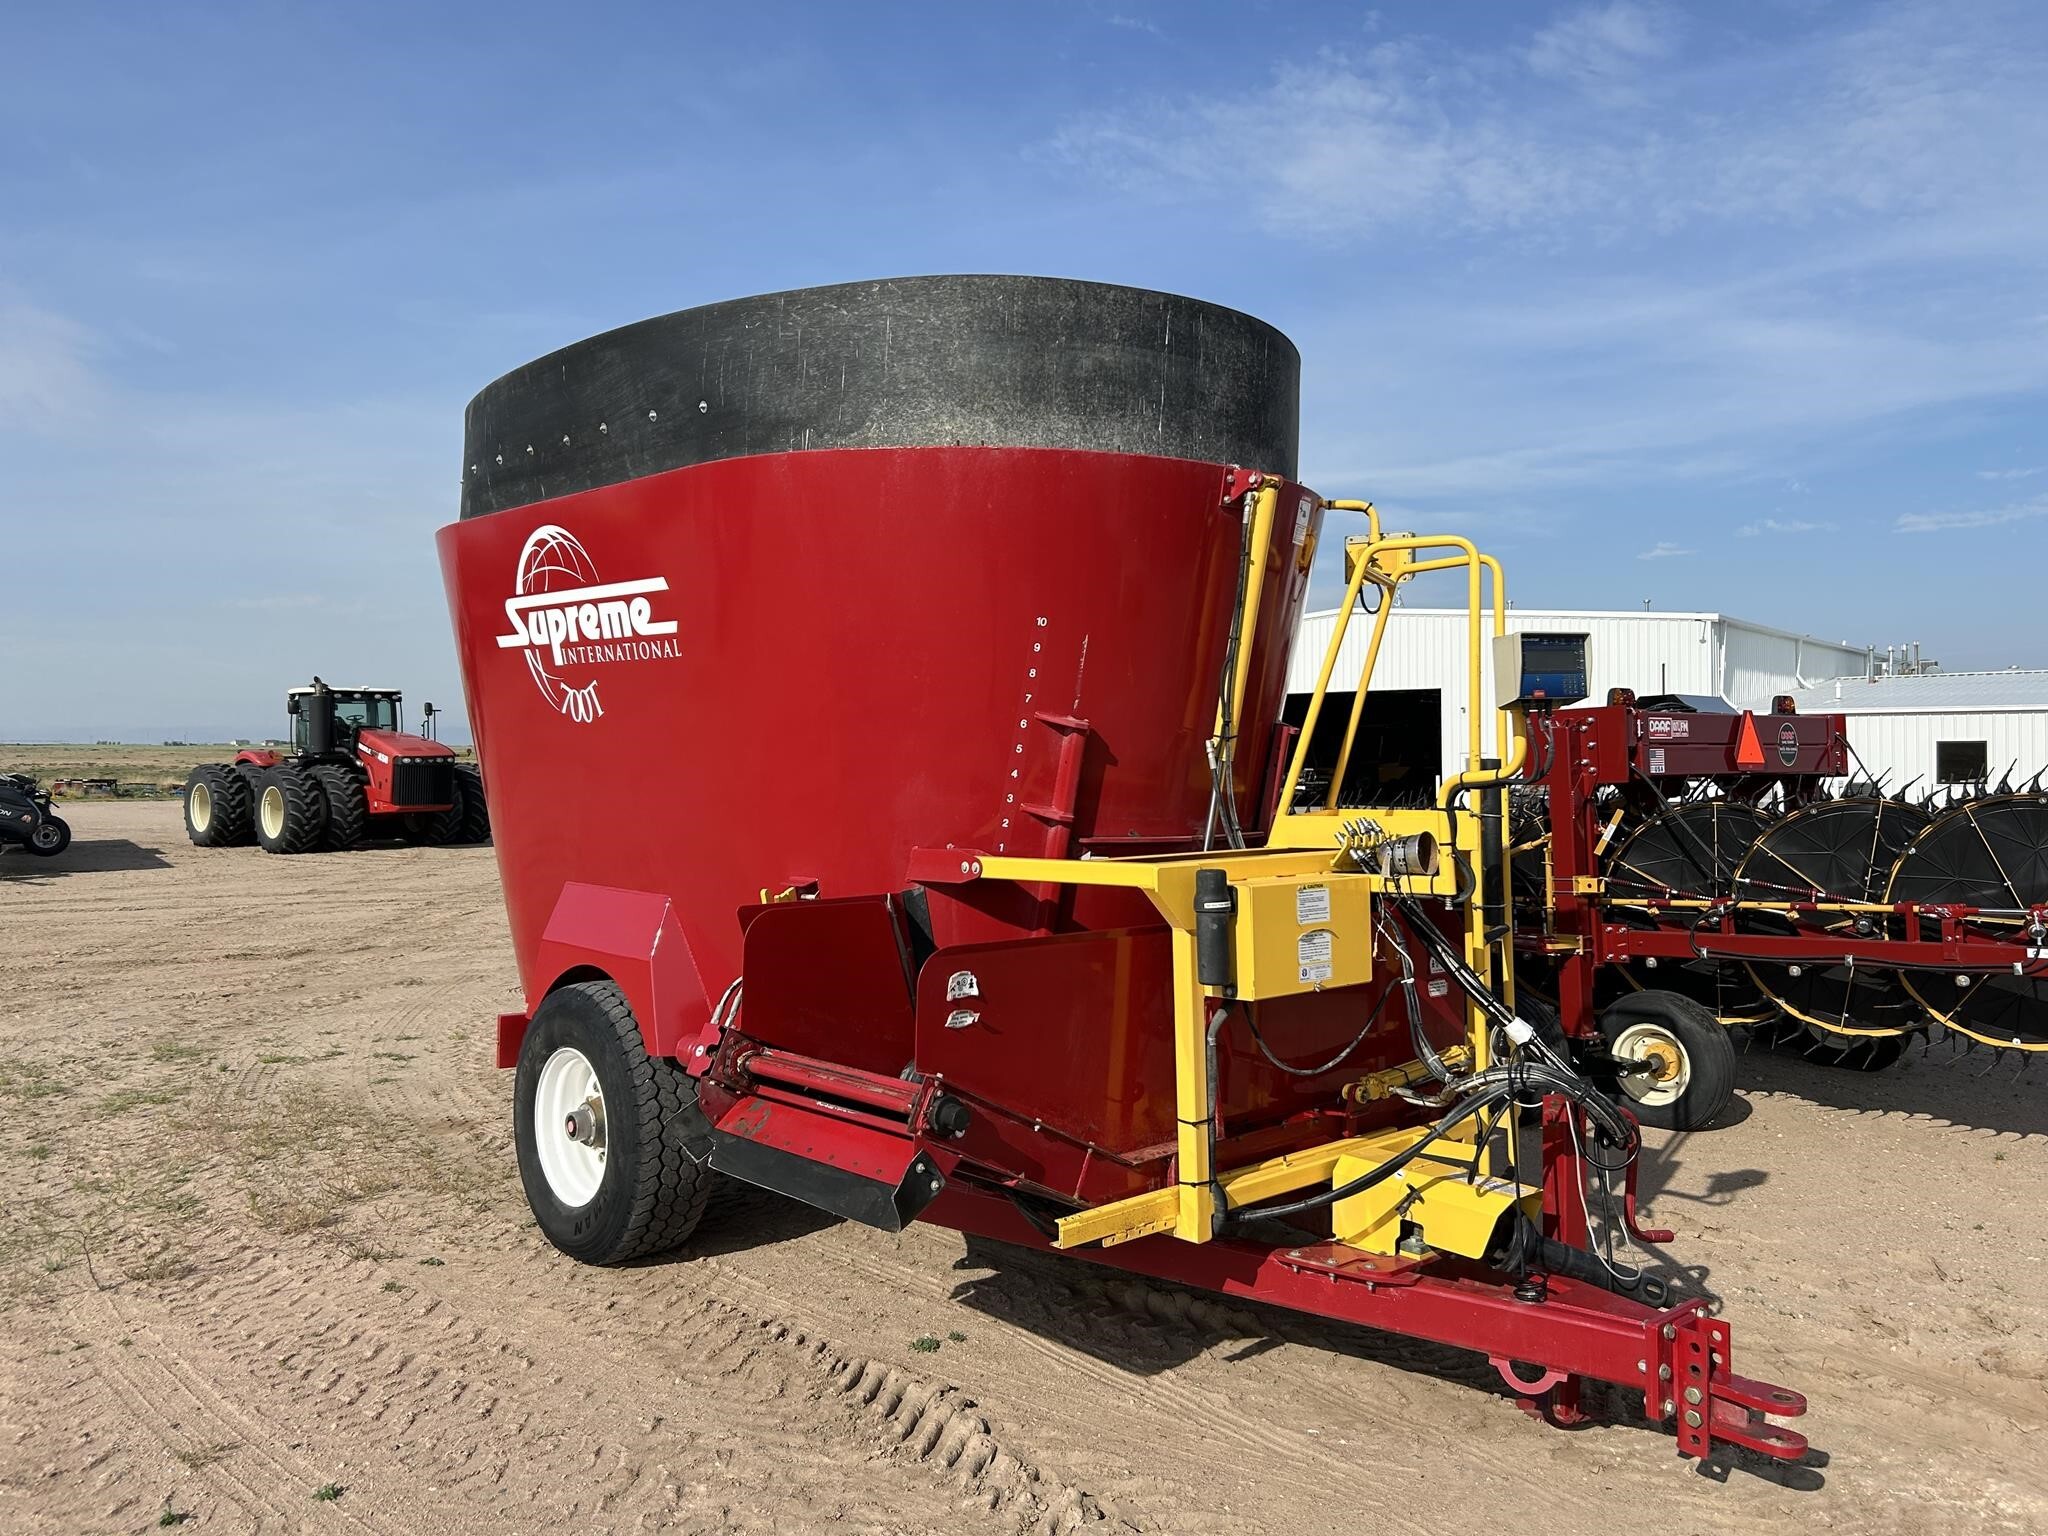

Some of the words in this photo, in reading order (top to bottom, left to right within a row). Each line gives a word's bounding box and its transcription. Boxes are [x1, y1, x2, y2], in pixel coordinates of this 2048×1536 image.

[496, 577, 678, 666] Supreme
[1035, 616, 1048, 627] 10
[562, 639, 682, 665] INTERNATIONAL
[1033, 642, 1041, 653] 9
[1028, 668, 1037, 678] 8
[560, 680, 604, 723] 700T
[1025, 693, 1033, 703] 7
[1019, 718, 1028, 729] 6
[1015, 743, 1023, 754] 5
[1010, 769, 1019, 779] 4
[1006, 793, 1014, 804] 3
[1001, 818, 1010, 828] 2
[999, 842, 1004, 852] 1
